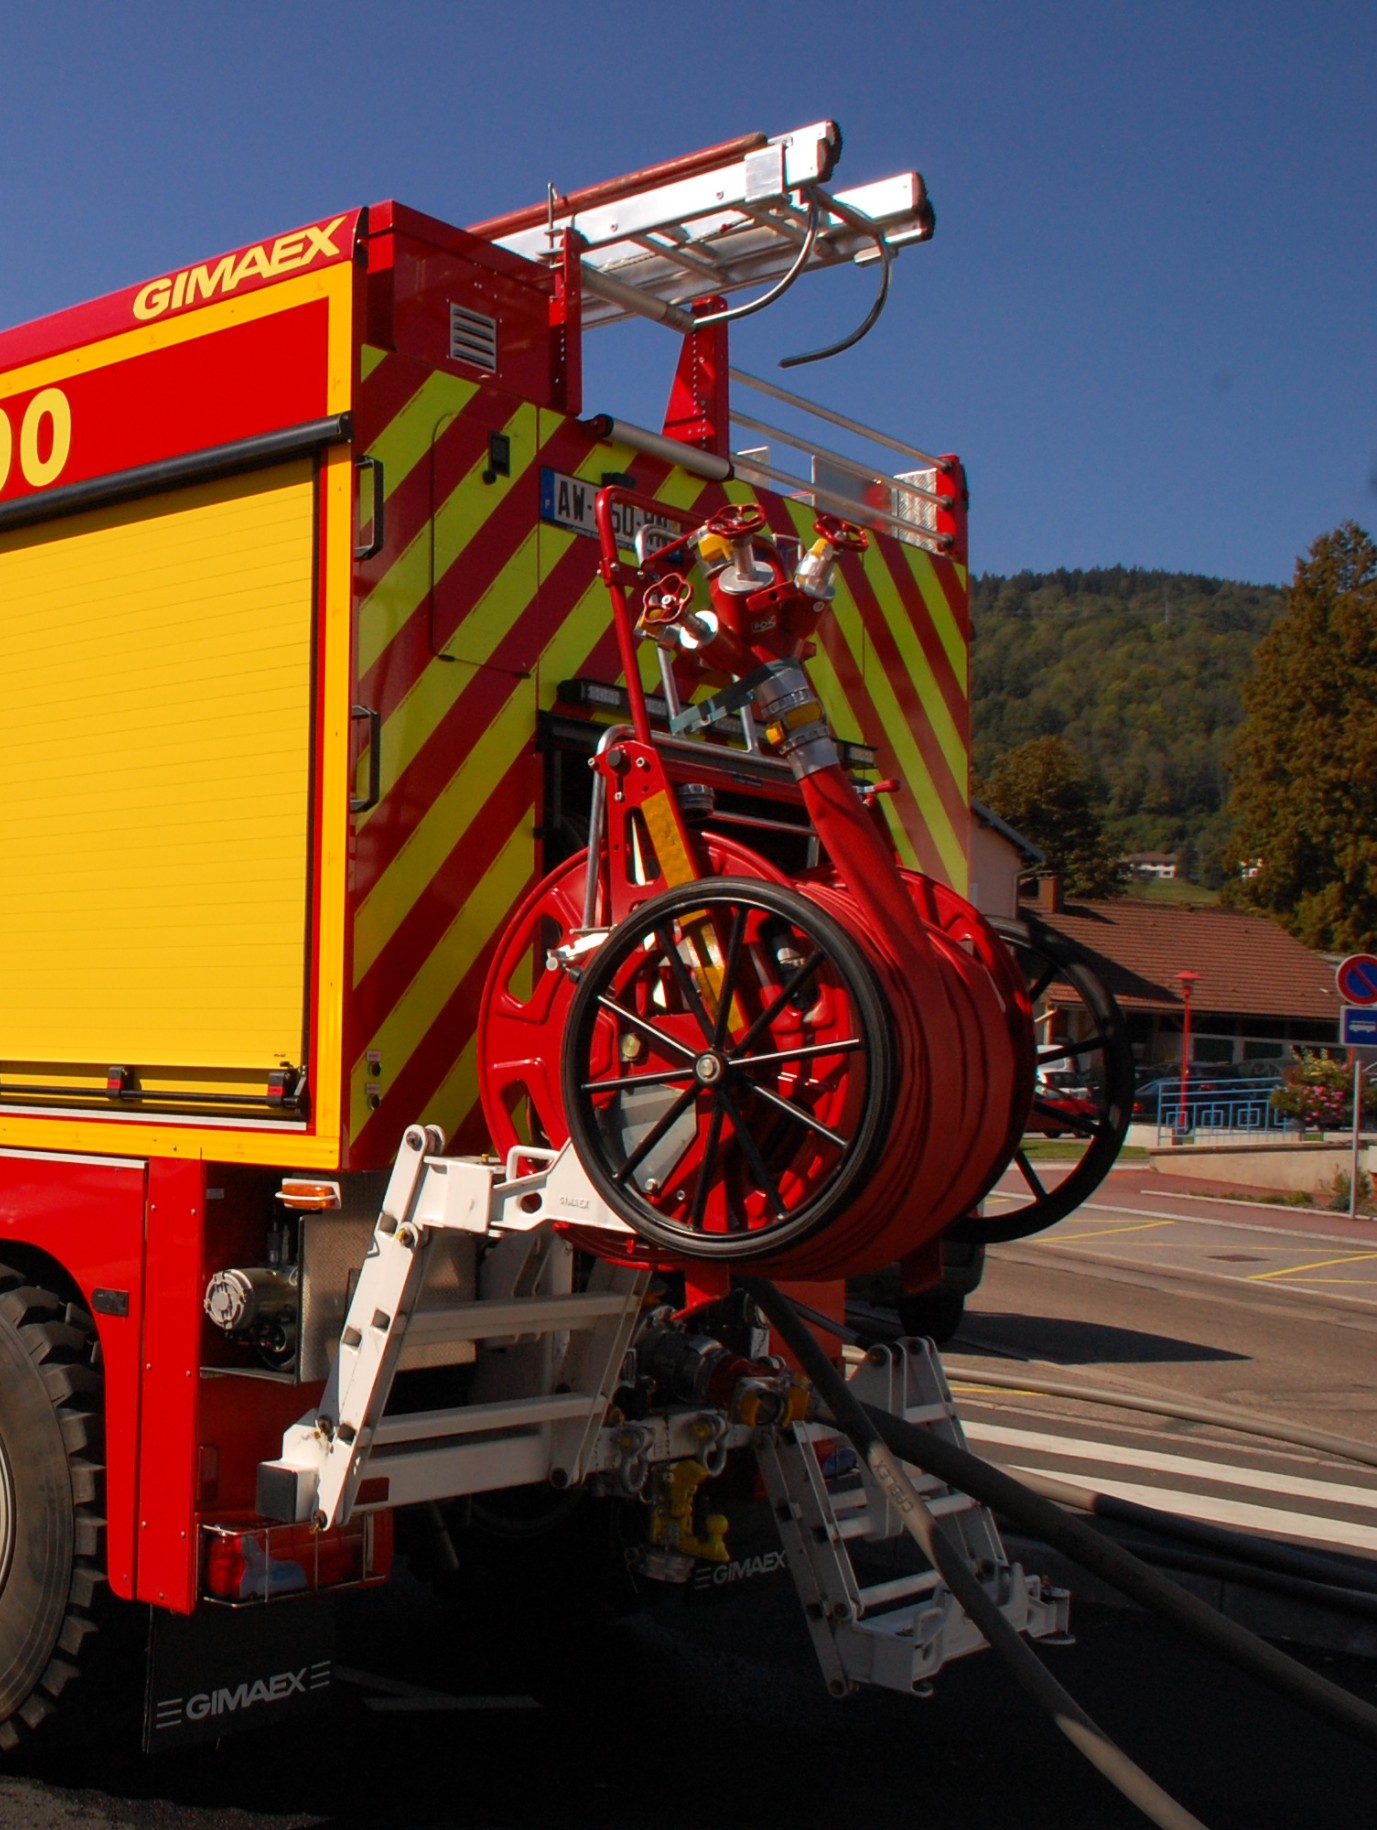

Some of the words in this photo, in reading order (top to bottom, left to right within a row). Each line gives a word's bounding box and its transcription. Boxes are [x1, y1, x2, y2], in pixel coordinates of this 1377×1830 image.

[132, 216, 347, 321] GIMAEX
[713, 1550, 786, 1584] GIMAEX
[185, 1667, 307, 1720] GIMAEX
